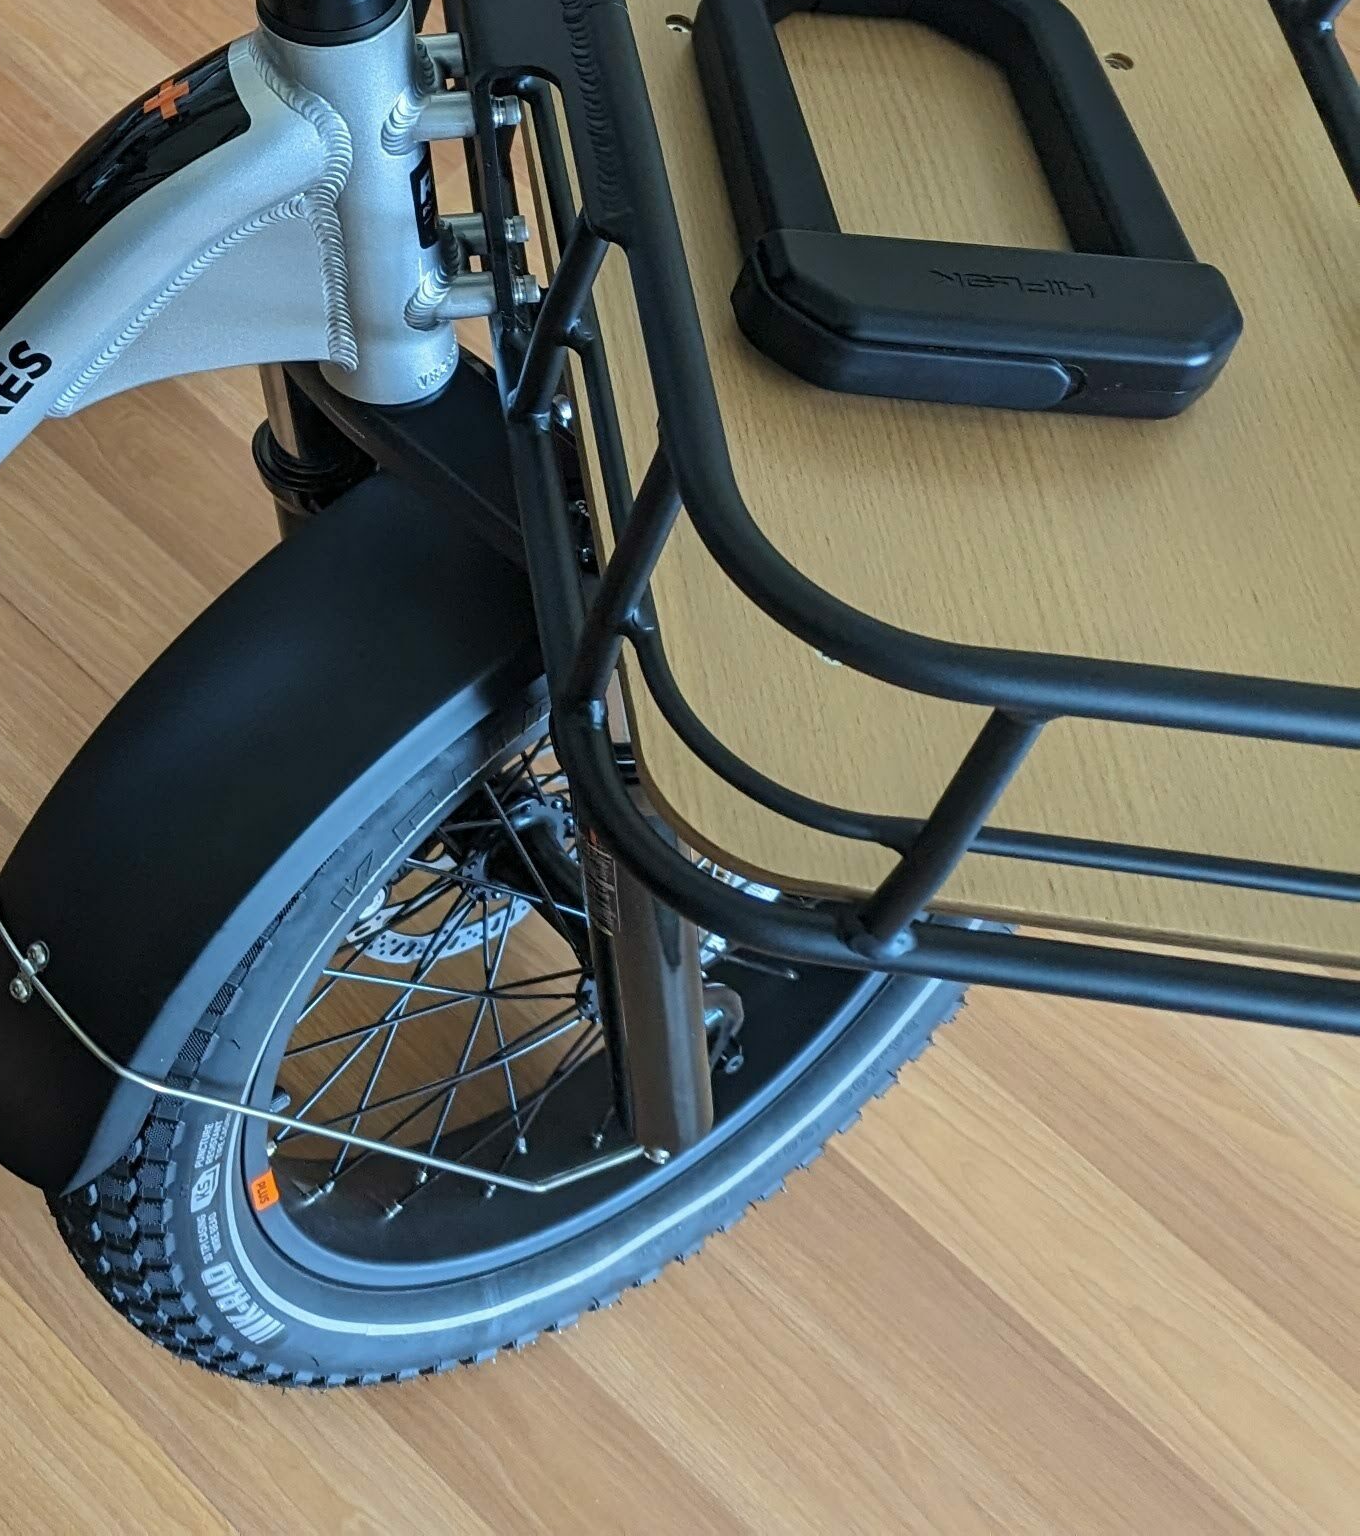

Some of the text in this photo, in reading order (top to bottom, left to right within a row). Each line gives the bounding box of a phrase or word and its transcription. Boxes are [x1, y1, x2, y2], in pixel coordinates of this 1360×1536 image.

[194, 1122, 215, 1169] PUNCTURE
[205, 1120, 224, 1165] RESISTANT
[256, 1180, 271, 1208] PLUS
[193, 1214, 211, 1242] CASING
